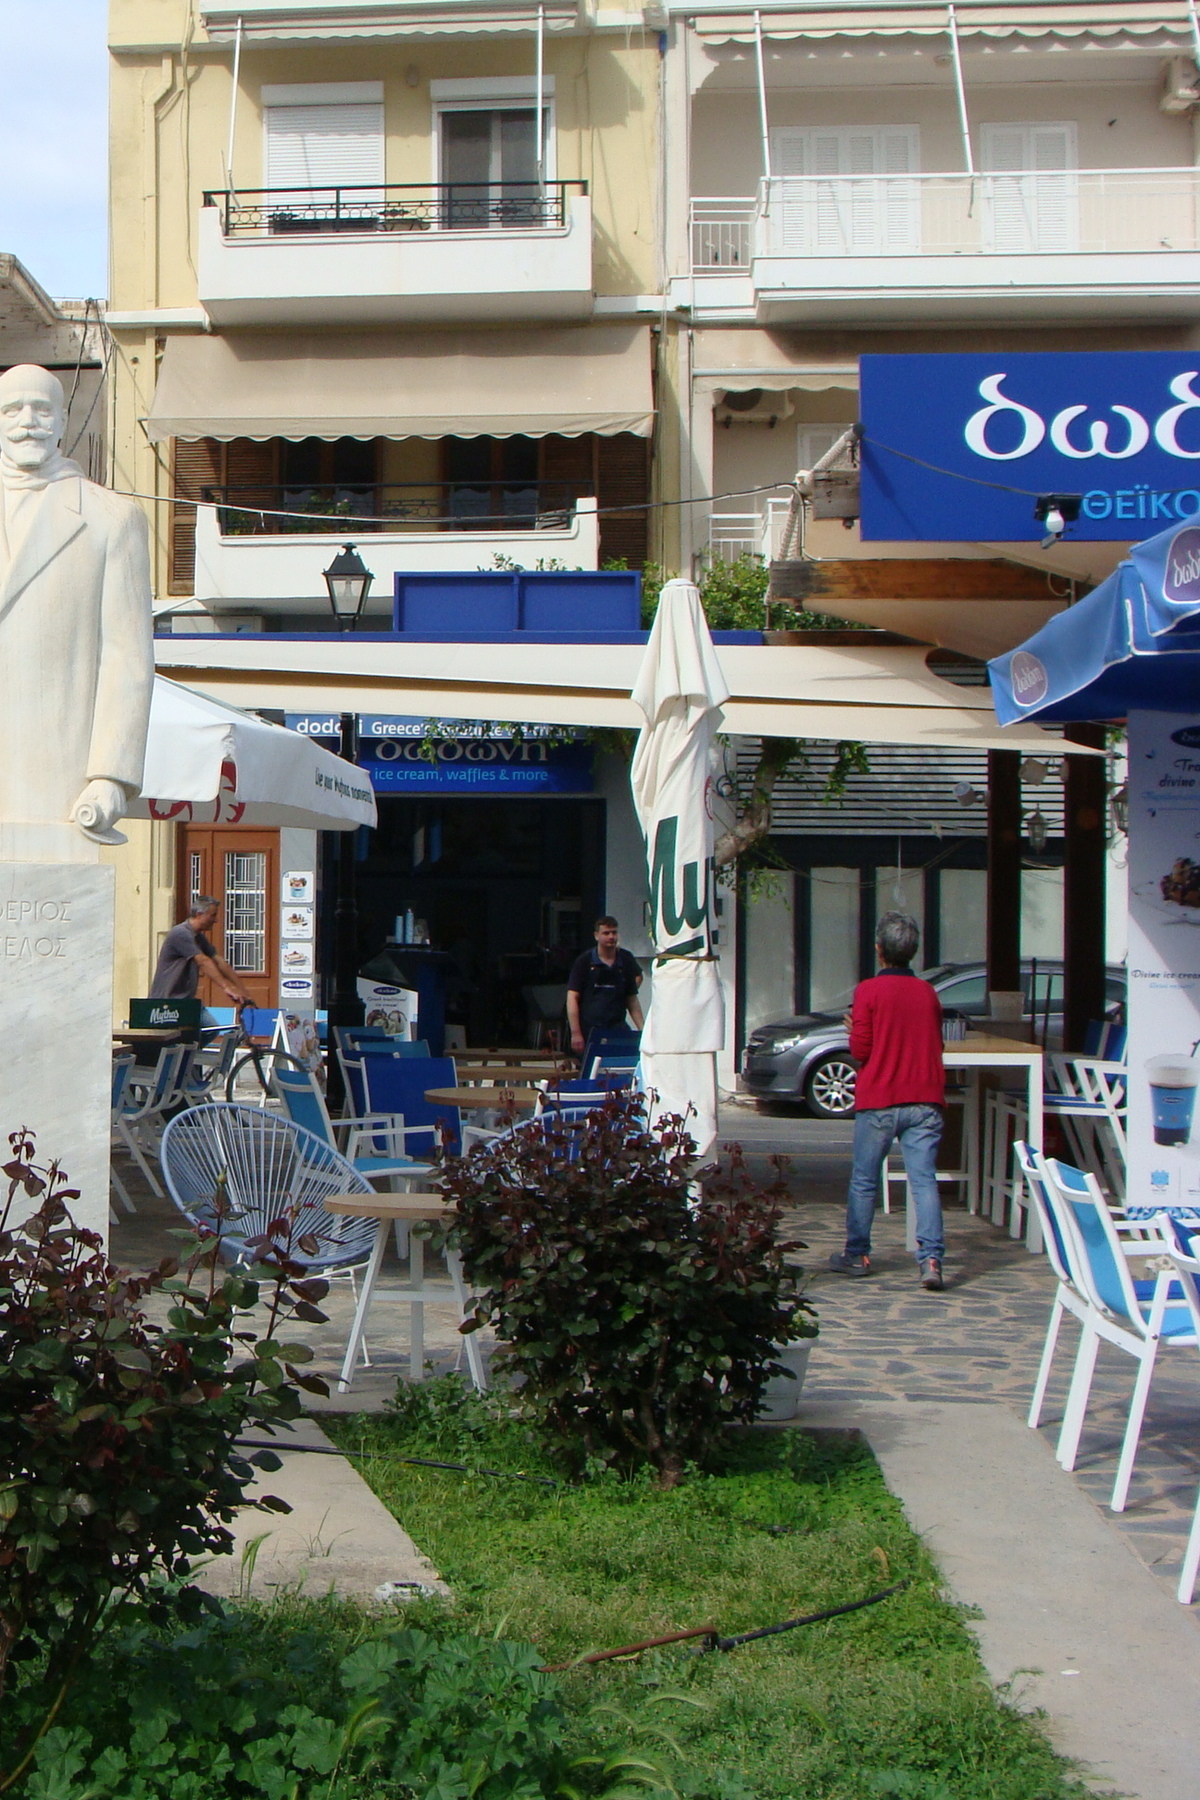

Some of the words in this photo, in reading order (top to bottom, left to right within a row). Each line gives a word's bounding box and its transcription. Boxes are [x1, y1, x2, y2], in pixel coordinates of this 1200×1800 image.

[296, 718, 363, 735] dodoi
[374, 768, 394, 780] ice
[397, 769, 443, 782] cream,
[447, 768, 495, 782] waffles
[500, 769, 509, 780] &
[512, 770, 548, 780] more
[1158, 774, 1196, 788] divine
[150, 1006, 179, 1024] Mythos
